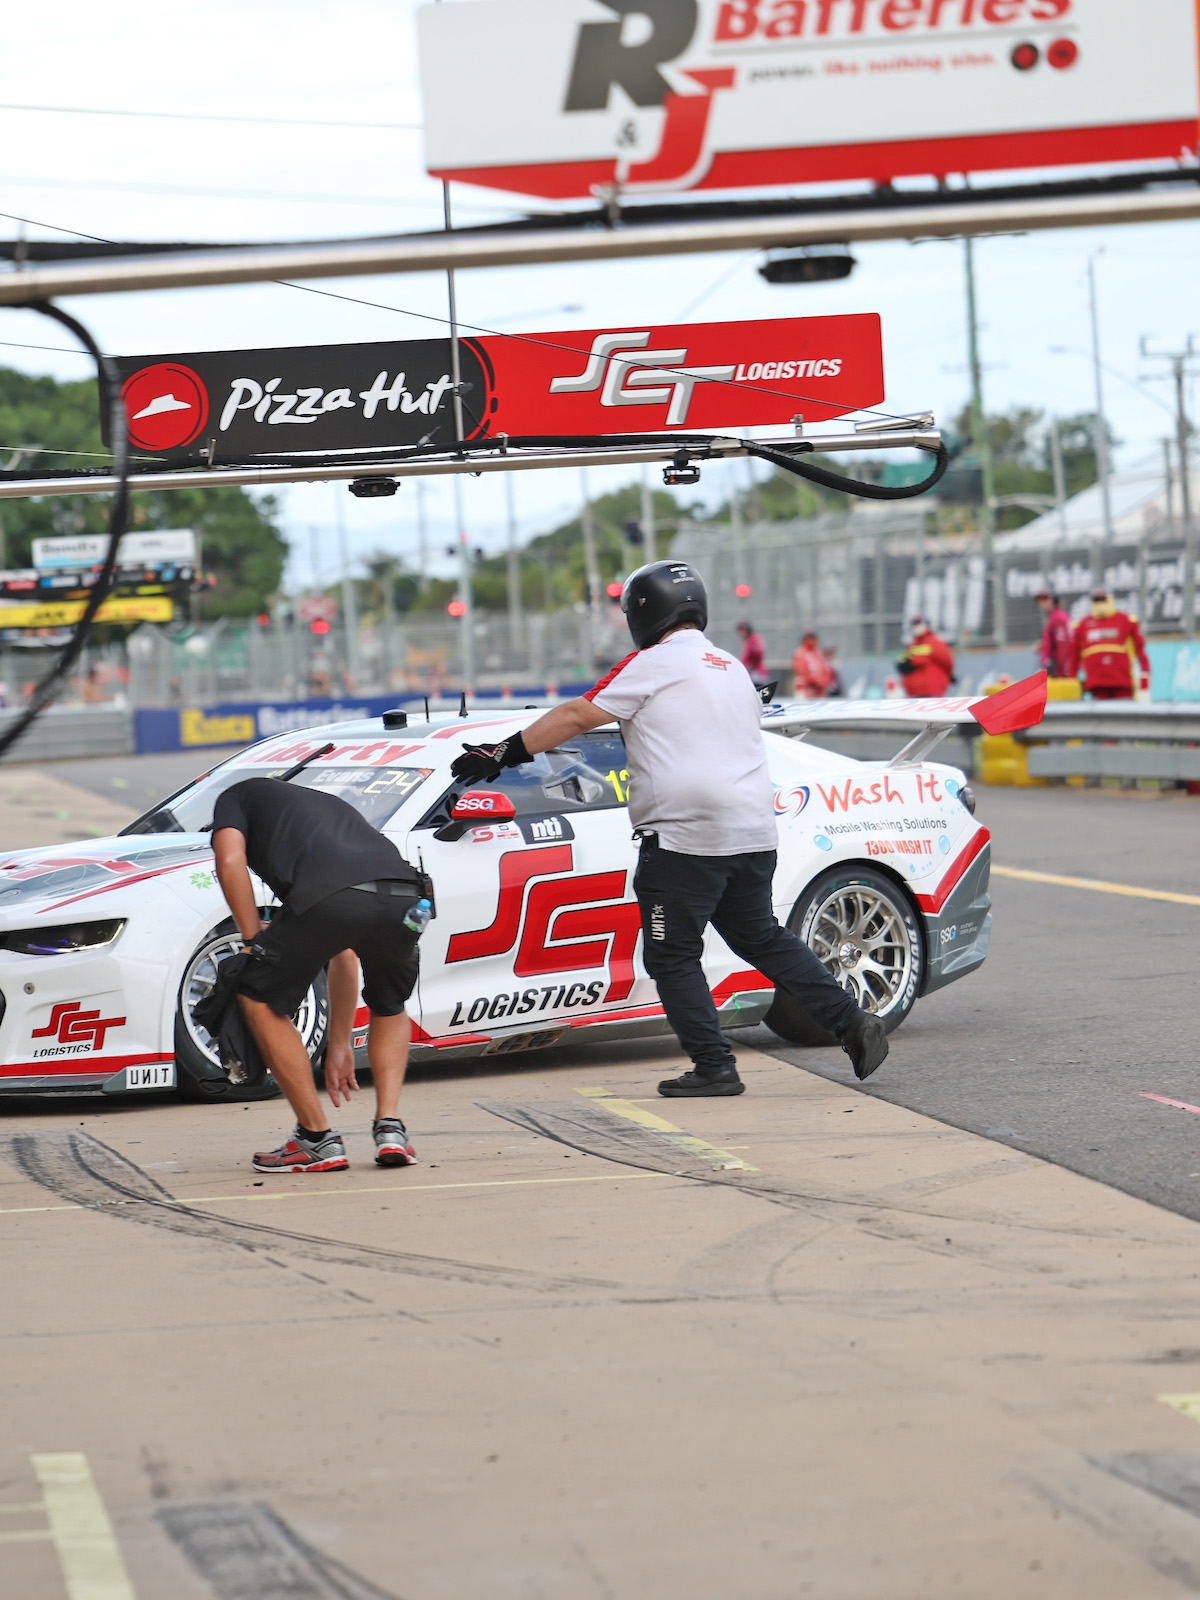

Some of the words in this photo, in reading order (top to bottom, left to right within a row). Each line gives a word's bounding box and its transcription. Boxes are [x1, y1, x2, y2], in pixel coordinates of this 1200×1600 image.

[549, 331, 737, 426] SCT
[734, 358, 843, 382] LOGISTICS
[219, 377, 355, 431] Pizza
[359, 370, 457, 419] Hut
[311, 769, 372, 784] Evans
[363, 770, 427, 796] 24
[455, 798, 494, 811] SSG
[816, 775, 904, 812] Wash
[916, 773, 942, 803] It
[530, 817, 563, 838] nti
[824, 824, 862, 836] Mobile
[862, 820, 903, 833] Washing
[904, 817, 947, 830] Solutions
[864, 841, 893, 856] 1300
[893, 840, 922, 854] WASH
[923, 839, 932, 854] IT
[445, 843, 643, 1004] SCT
[651, 912, 665, 941] UNIT
[941, 925, 956, 945] SSG
[902, 929, 920, 1011] DUNLOP
[449, 981, 604, 1028] LOGISTICS
[31, 1001, 127, 1050] SCT
[33, 1043, 92, 1058] LOGISTICS
[130, 1068, 170, 1086] UNIT
